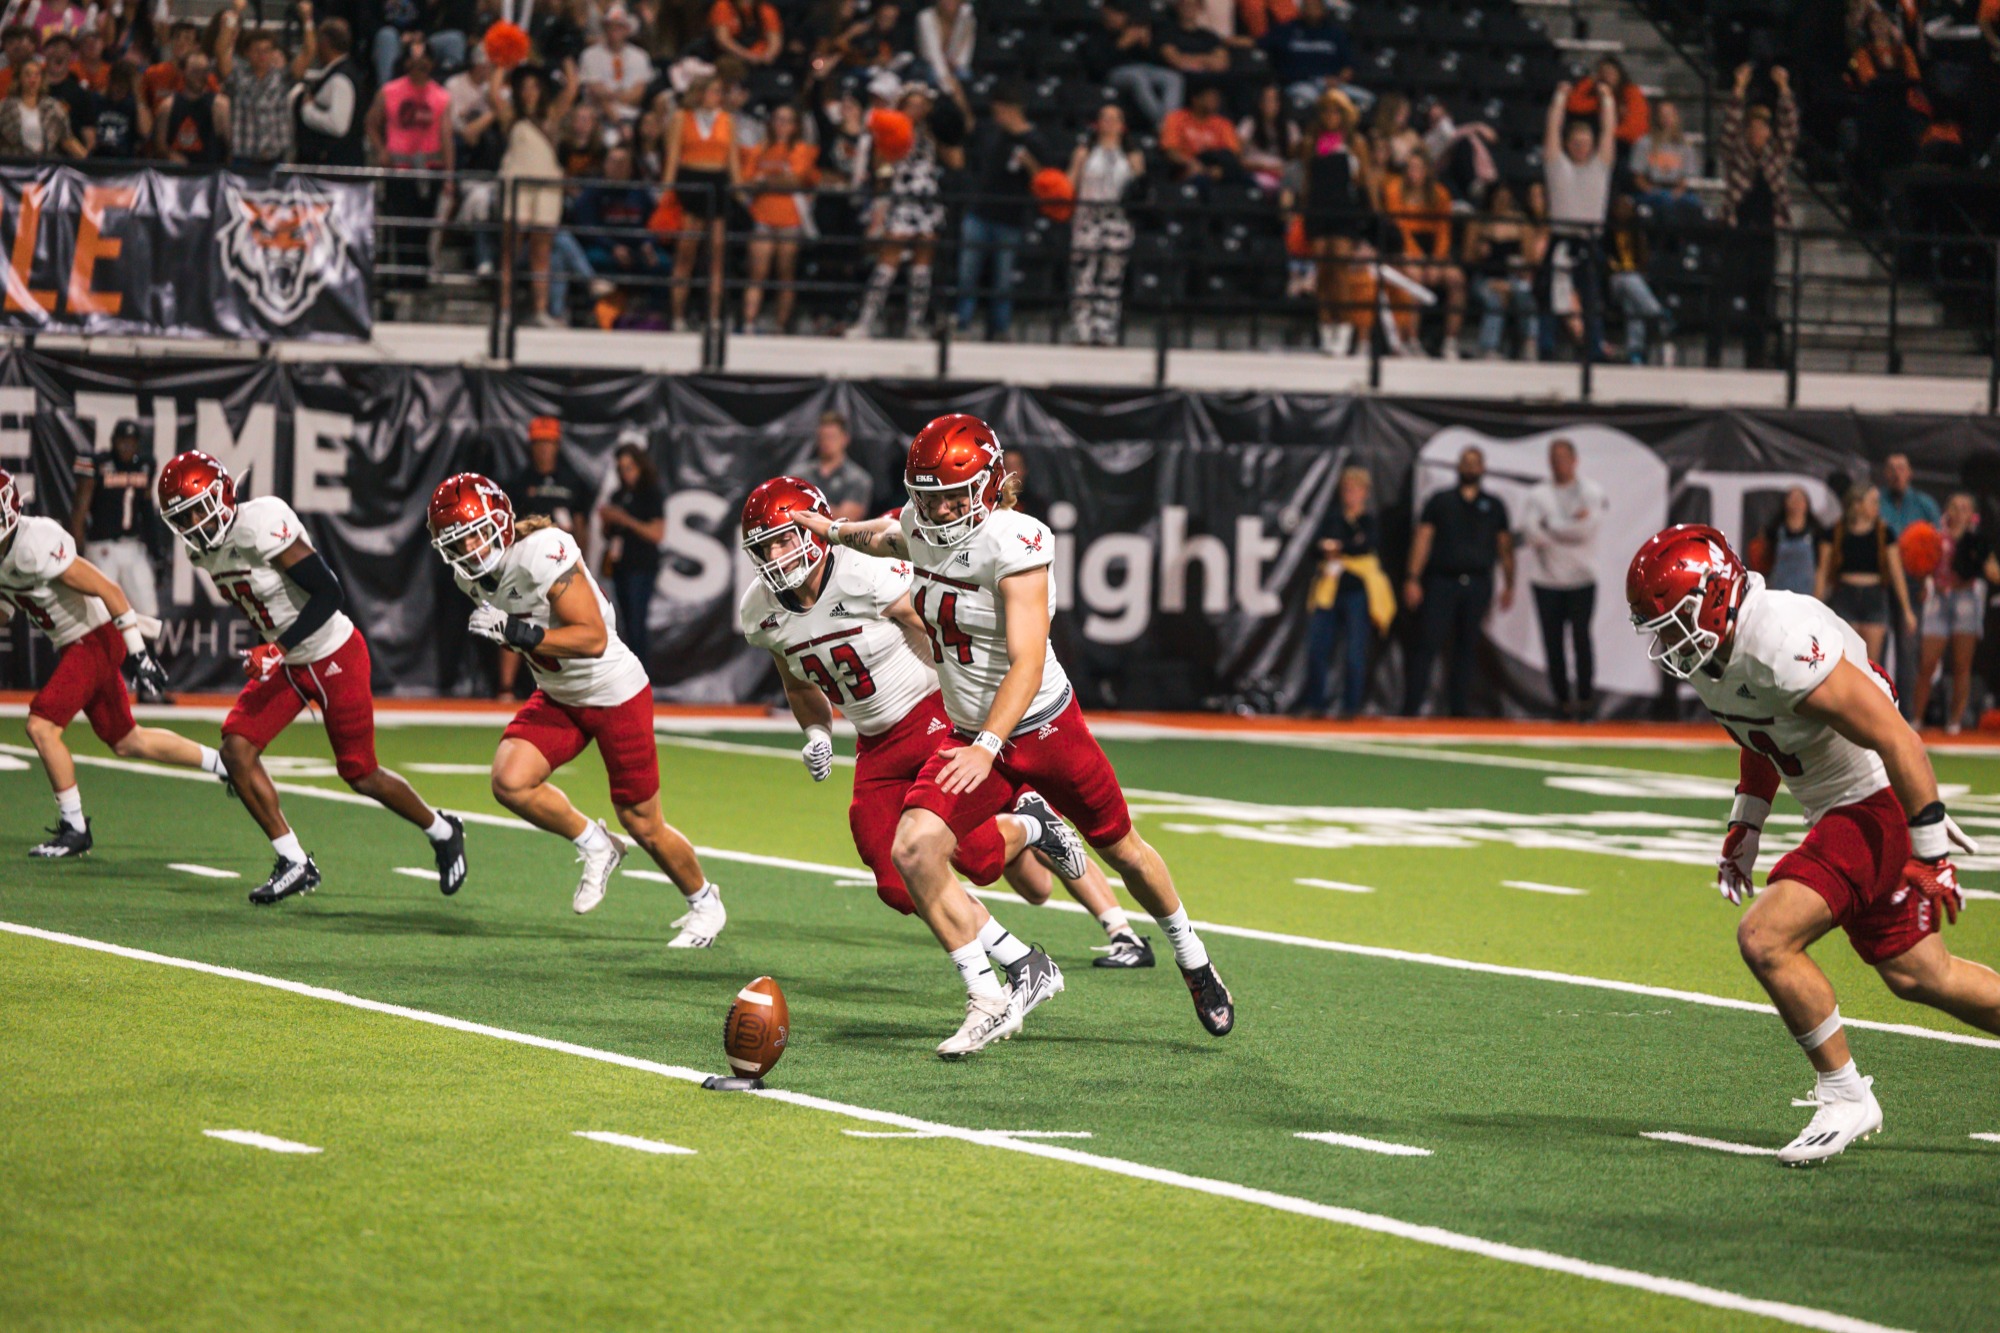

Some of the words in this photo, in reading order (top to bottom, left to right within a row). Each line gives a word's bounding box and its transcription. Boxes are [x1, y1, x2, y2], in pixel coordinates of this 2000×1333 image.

[0, 183, 137, 314] LE
[75, 389, 353, 513] TIME
[800, 642, 877, 705] 33
[914, 585, 974, 665] 14
